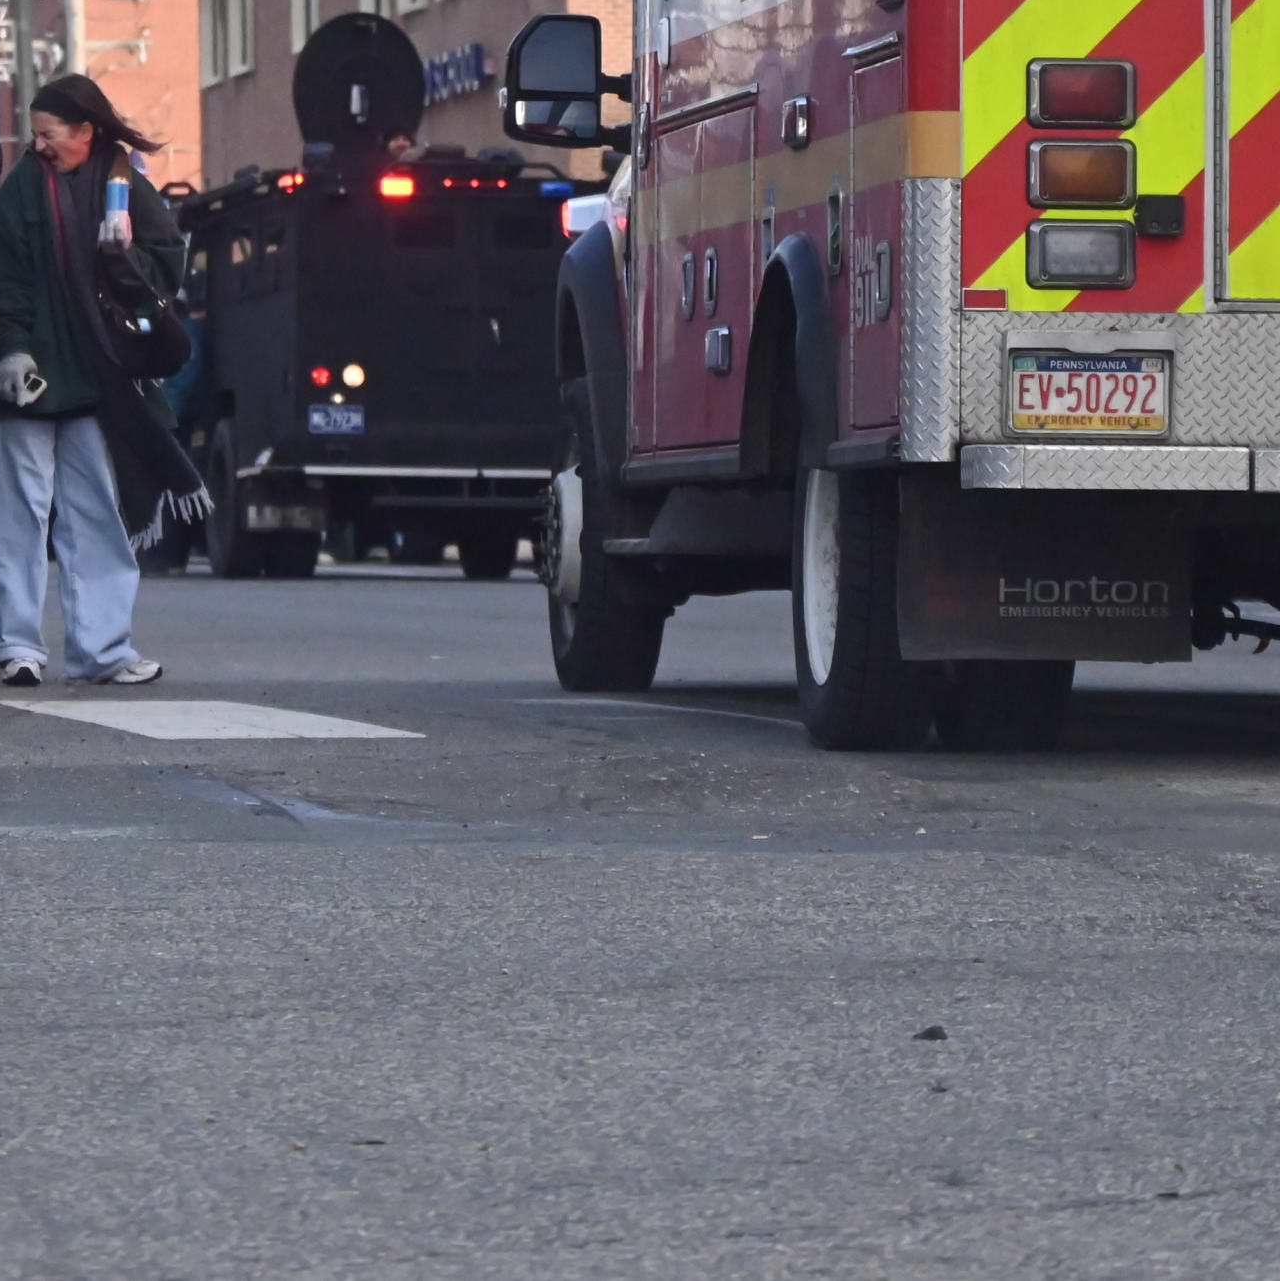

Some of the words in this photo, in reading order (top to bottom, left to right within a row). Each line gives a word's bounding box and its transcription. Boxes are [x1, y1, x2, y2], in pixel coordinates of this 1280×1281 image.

[855, 274, 876, 329] 911
[1049, 360, 1128, 371] PENNSYLVANIA
[1027, 415, 1093, 426] EMERGENCY
[1099, 415, 1151, 427] VEHICLE
[999, 575, 1169, 603] Horton
[999, 605, 1091, 618] EMERGENCY
[1096, 605, 1170, 618] VEHICLES
